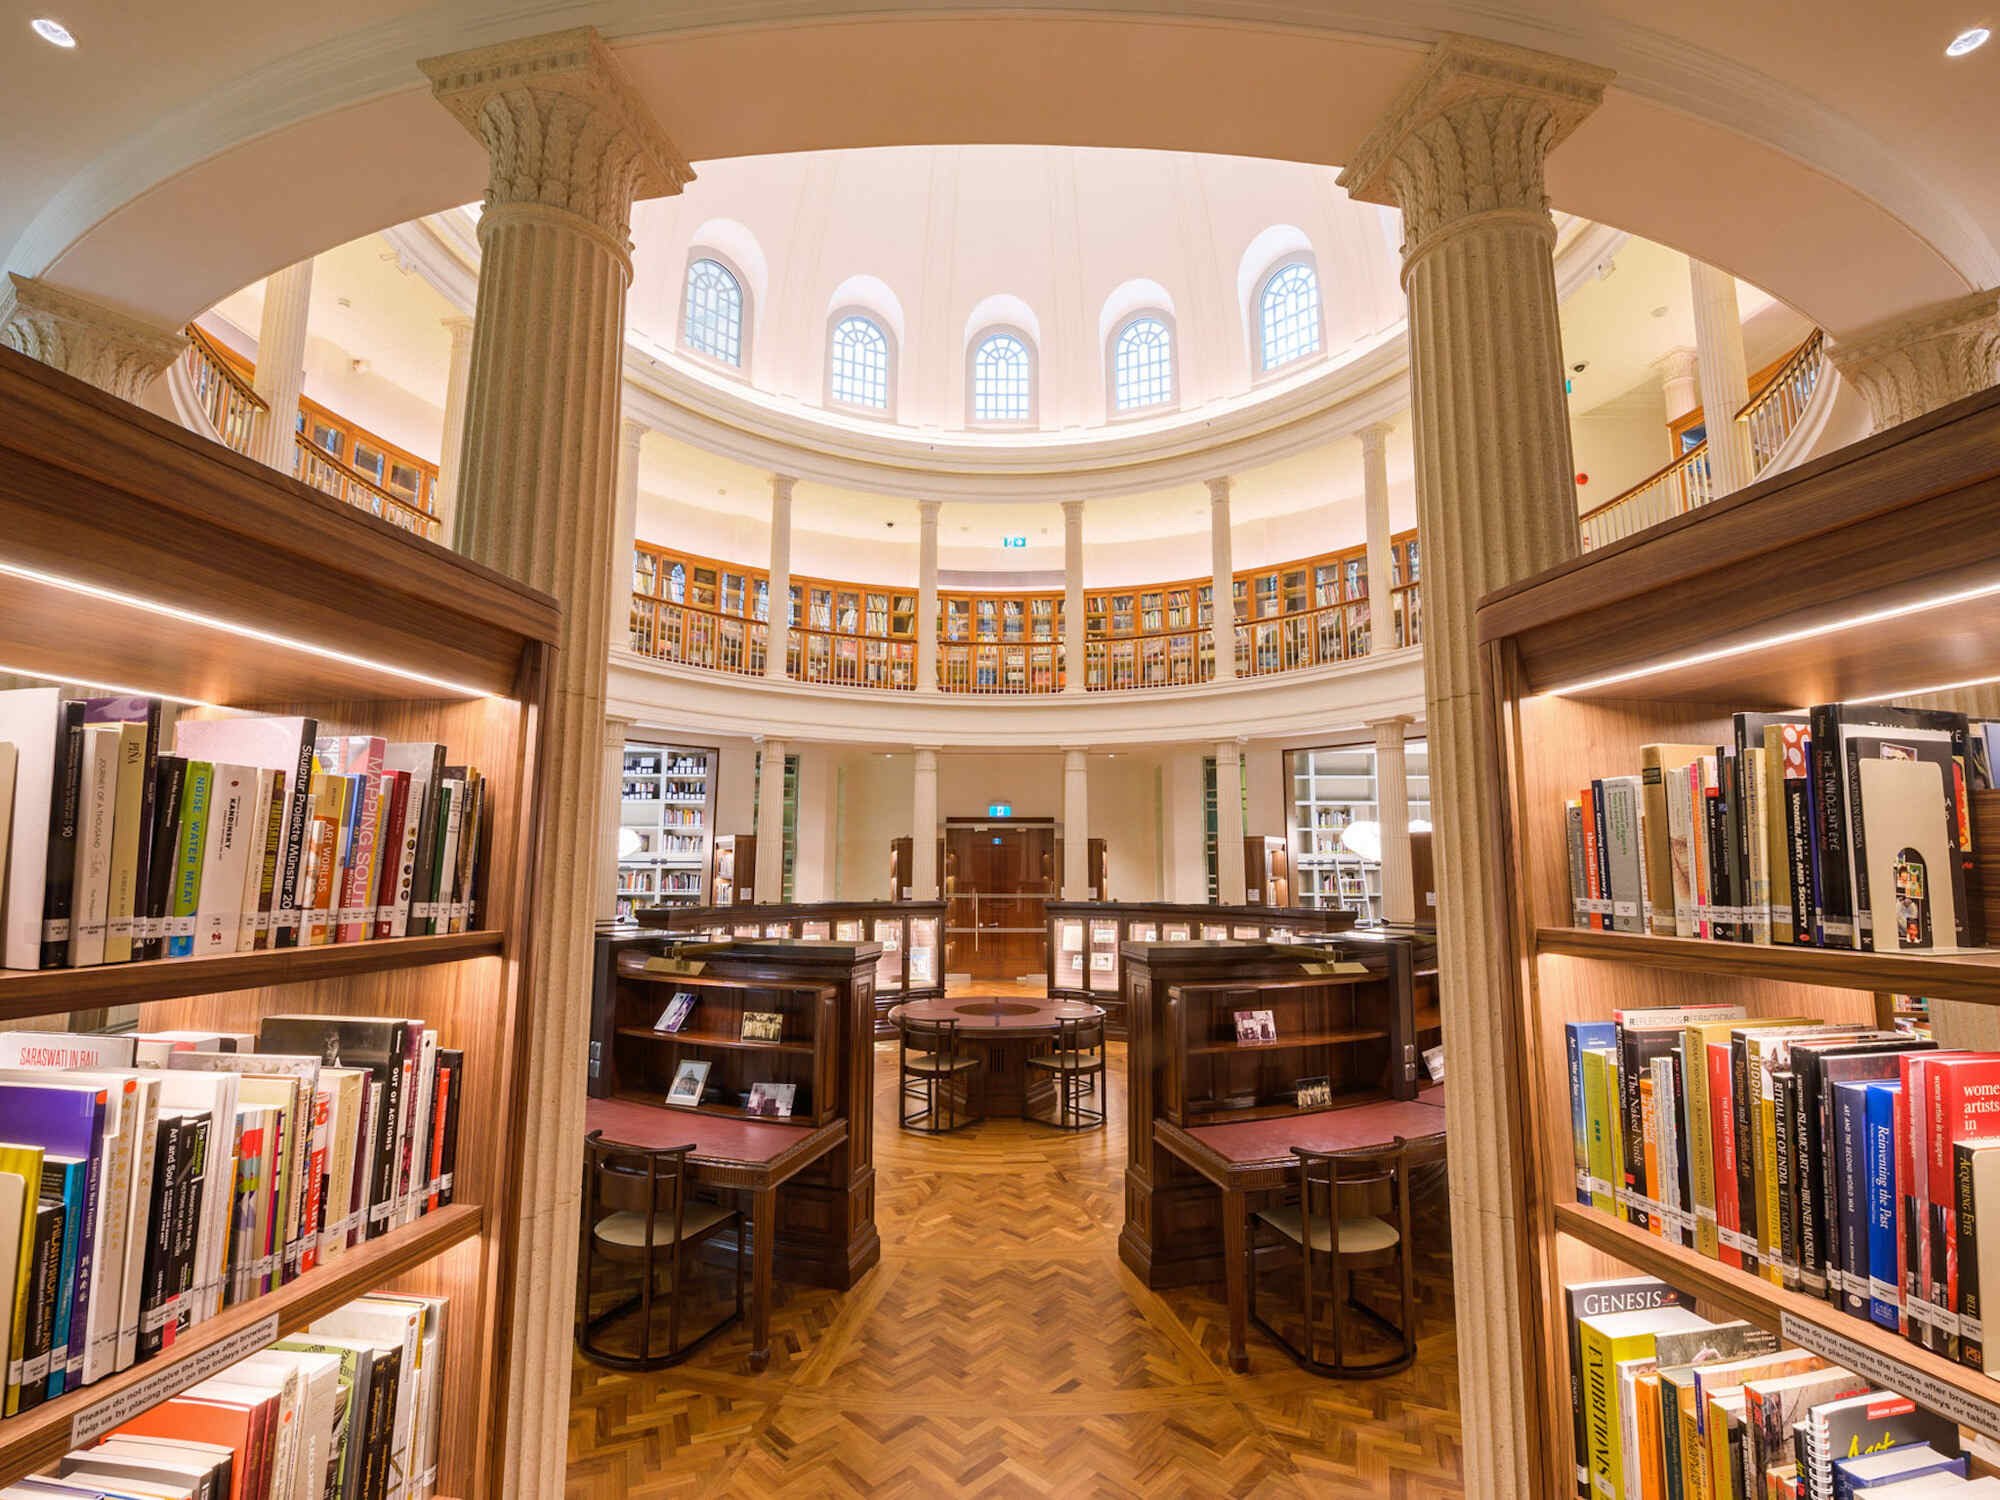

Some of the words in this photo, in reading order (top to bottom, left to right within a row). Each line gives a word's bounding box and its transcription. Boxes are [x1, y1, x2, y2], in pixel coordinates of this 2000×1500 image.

[297, 745, 311, 791] Skulptur
[192, 776, 206, 813] NOISE
[359, 756, 383, 846] MAPPING
[1824, 771, 1839, 829] INNOCENT
[225, 798, 236, 849] KANDINSKY
[291, 793, 306, 841] Projekte
[1792, 792, 1801, 837] WOMEN,
[187, 821, 201, 864] WATER
[324, 824, 333, 844] ART
[1586, 832, 1594, 847] the
[1795, 838, 1803, 861] ART,
[1829, 831, 1840, 852] EYE
[283, 844, 300, 892] Münster
[318, 847, 332, 893] WORLDS
[1587, 848, 1595, 875] studio
[1598, 848, 1607, 895] Contemporary
[183, 871, 195, 904] MEAT
[1798, 886, 1808, 928] SOCIETY
[20, 1048, 66, 1066] SARASWATI
[70, 1051, 78, 1066] IN
[79, 1051, 98, 1067] BALI
[391, 1067, 399, 1087] OUT
[1628, 1073, 1639, 1095] The
[1735, 1060, 1745, 1105] Pilgrimage
[390, 1091, 396, 1104] OF
[1773, 1082, 1784, 1119] RITUAL
[1935, 1102, 1943, 1122] artists
[385, 1108, 395, 1150] ACTIONS
[1629, 1097, 1640, 1132] Naked
[1738, 1106, 1747, 1123] and
[1776, 1119, 1785, 1138] ART
[1843, 1117, 1851, 1132] AND
[1936, 1123, 1944, 1132] in
[1964, 1115, 1977, 1130] in
[168, 1128, 178, 1145] Art
[1739, 1124, 1749, 1161] Buddhist
[1777, 1139, 1786, 1154] OF
[1797, 1112, 1808, 1150] ISLAMIC
[1844, 1133, 1852, 1146] THE
[168, 1146, 176, 1163] and
[1633, 1135, 1643, 1166] Nude
[1799, 1151, 1809, 1171] ART
[1845, 1147, 1853, 1172] SECOND
[1876, 1125, 1890, 1187] Reinventing
[1935, 1133, 1945, 1167] singapore
[165, 1165, 176, 1187] Soul
[1741, 1162, 1750, 1178] Art
[1778, 1155, 1787, 1185] INDIA
[1959, 1157, 1972, 1211] ACQUIRING
[87, 1192, 95, 1206] New
[1846, 1175, 1854, 1198] WORLD
[1880, 1189, 1889, 1205] the
[1769, 1186, 1778, 1236] BUDDHIST
[1801, 1188, 1812, 1227] BRUNEI
[1847, 1199, 1855, 1213] WAR
[1880, 1207, 1892, 1228] Past
[85, 1207, 95, 1238] Frontiers
[1963, 1213, 1974, 1236] EYES
[1804, 1228, 1814, 1270] MUSEUM
[1584, 1290, 1663, 1314] GENESIS
[78, 1403, 110, 1425] Please
[113, 1397, 124, 1408] do
[127, 1389, 143, 1403] not
[144, 1369, 179, 1396] reshelve
[181, 1362, 194, 1374] the
[196, 1349, 220, 1365] books
[221, 1340, 238, 1353] after
[1785, 1316, 1810, 1334] Please
[1812, 1327, 1822, 1340] do
[1824, 1335, 1838, 1346] not
[1839, 1342, 1875, 1363] reshelve
[1877, 1358, 1891, 1370] the
[1893, 1366, 1921, 1386] books
[1923, 1378, 1947, 1396] after
[1948, 1391, 2000, 1421] browsing.
[1785, 1327, 1803, 1341] Help
[1805, 1336, 1814, 1347] us
[1816, 1341, 1826, 1353] by
[1828, 1346, 1858, 1368] placing
[1860, 1362, 1882, 1378] them
[1884, 1374, 1896, 1384] on
[1897, 1379, 1913, 1392] the
[1915, 1386, 1951, 1411] trolleys
[1953, 1406, 1965, 1416] or
[77, 1421, 99, 1438] Help
[101, 1415, 112, 1426] us
[115, 1408, 126, 1419] by
[128, 1389, 161, 1414] placing
[163, 1378, 184, 1396] them
[185, 1372, 196, 1382] on
[197, 1363, 211, 1376] the
[211, 1347, 240, 1370] trolleys
[1588, 1345, 1609, 1475] EXHIBITIONS
